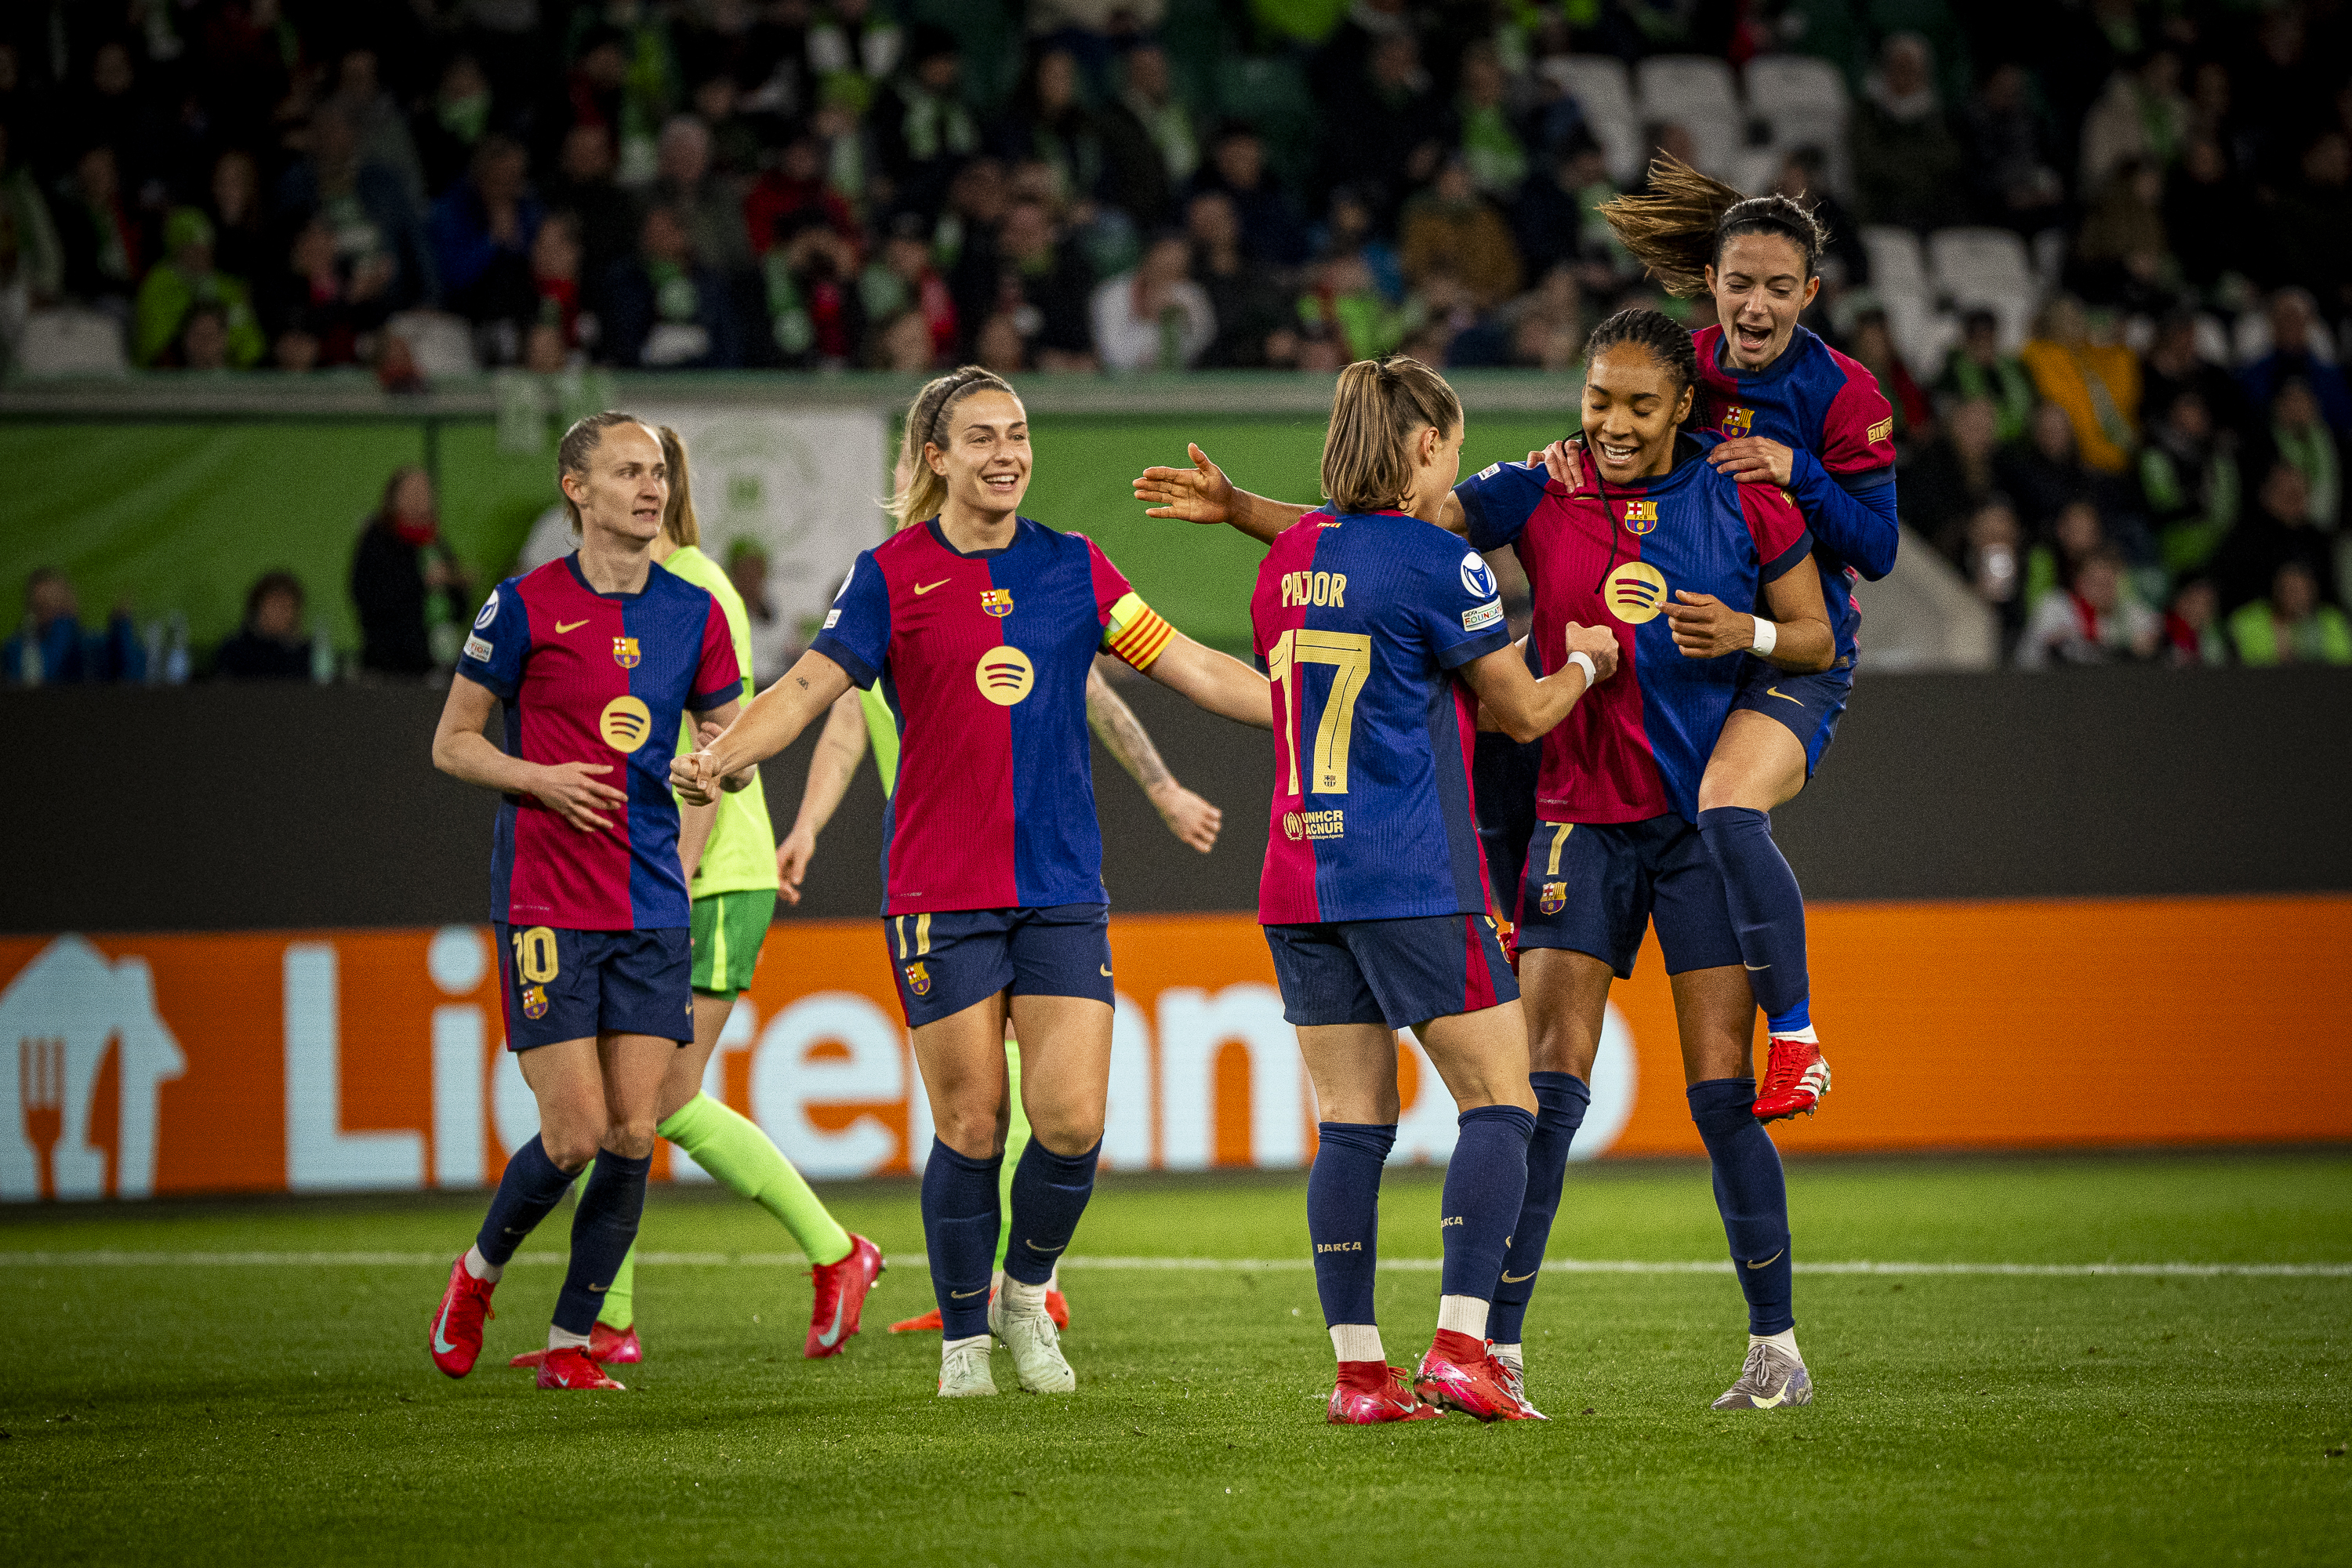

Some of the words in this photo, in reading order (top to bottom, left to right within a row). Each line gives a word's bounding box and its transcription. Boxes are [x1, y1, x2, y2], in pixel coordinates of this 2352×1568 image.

[1281, 571, 1347, 608] PAJOR
[1269, 629, 1371, 796] 17
[1301, 810, 1344, 824] UNHCR
[1305, 822, 1344, 835] ACNUR
[1545, 821, 1573, 876] 7
[512, 926, 560, 986] 10
[1440, 1216, 1464, 1229] ARÇA
[1317, 1241, 1363, 1254] BARÇA
